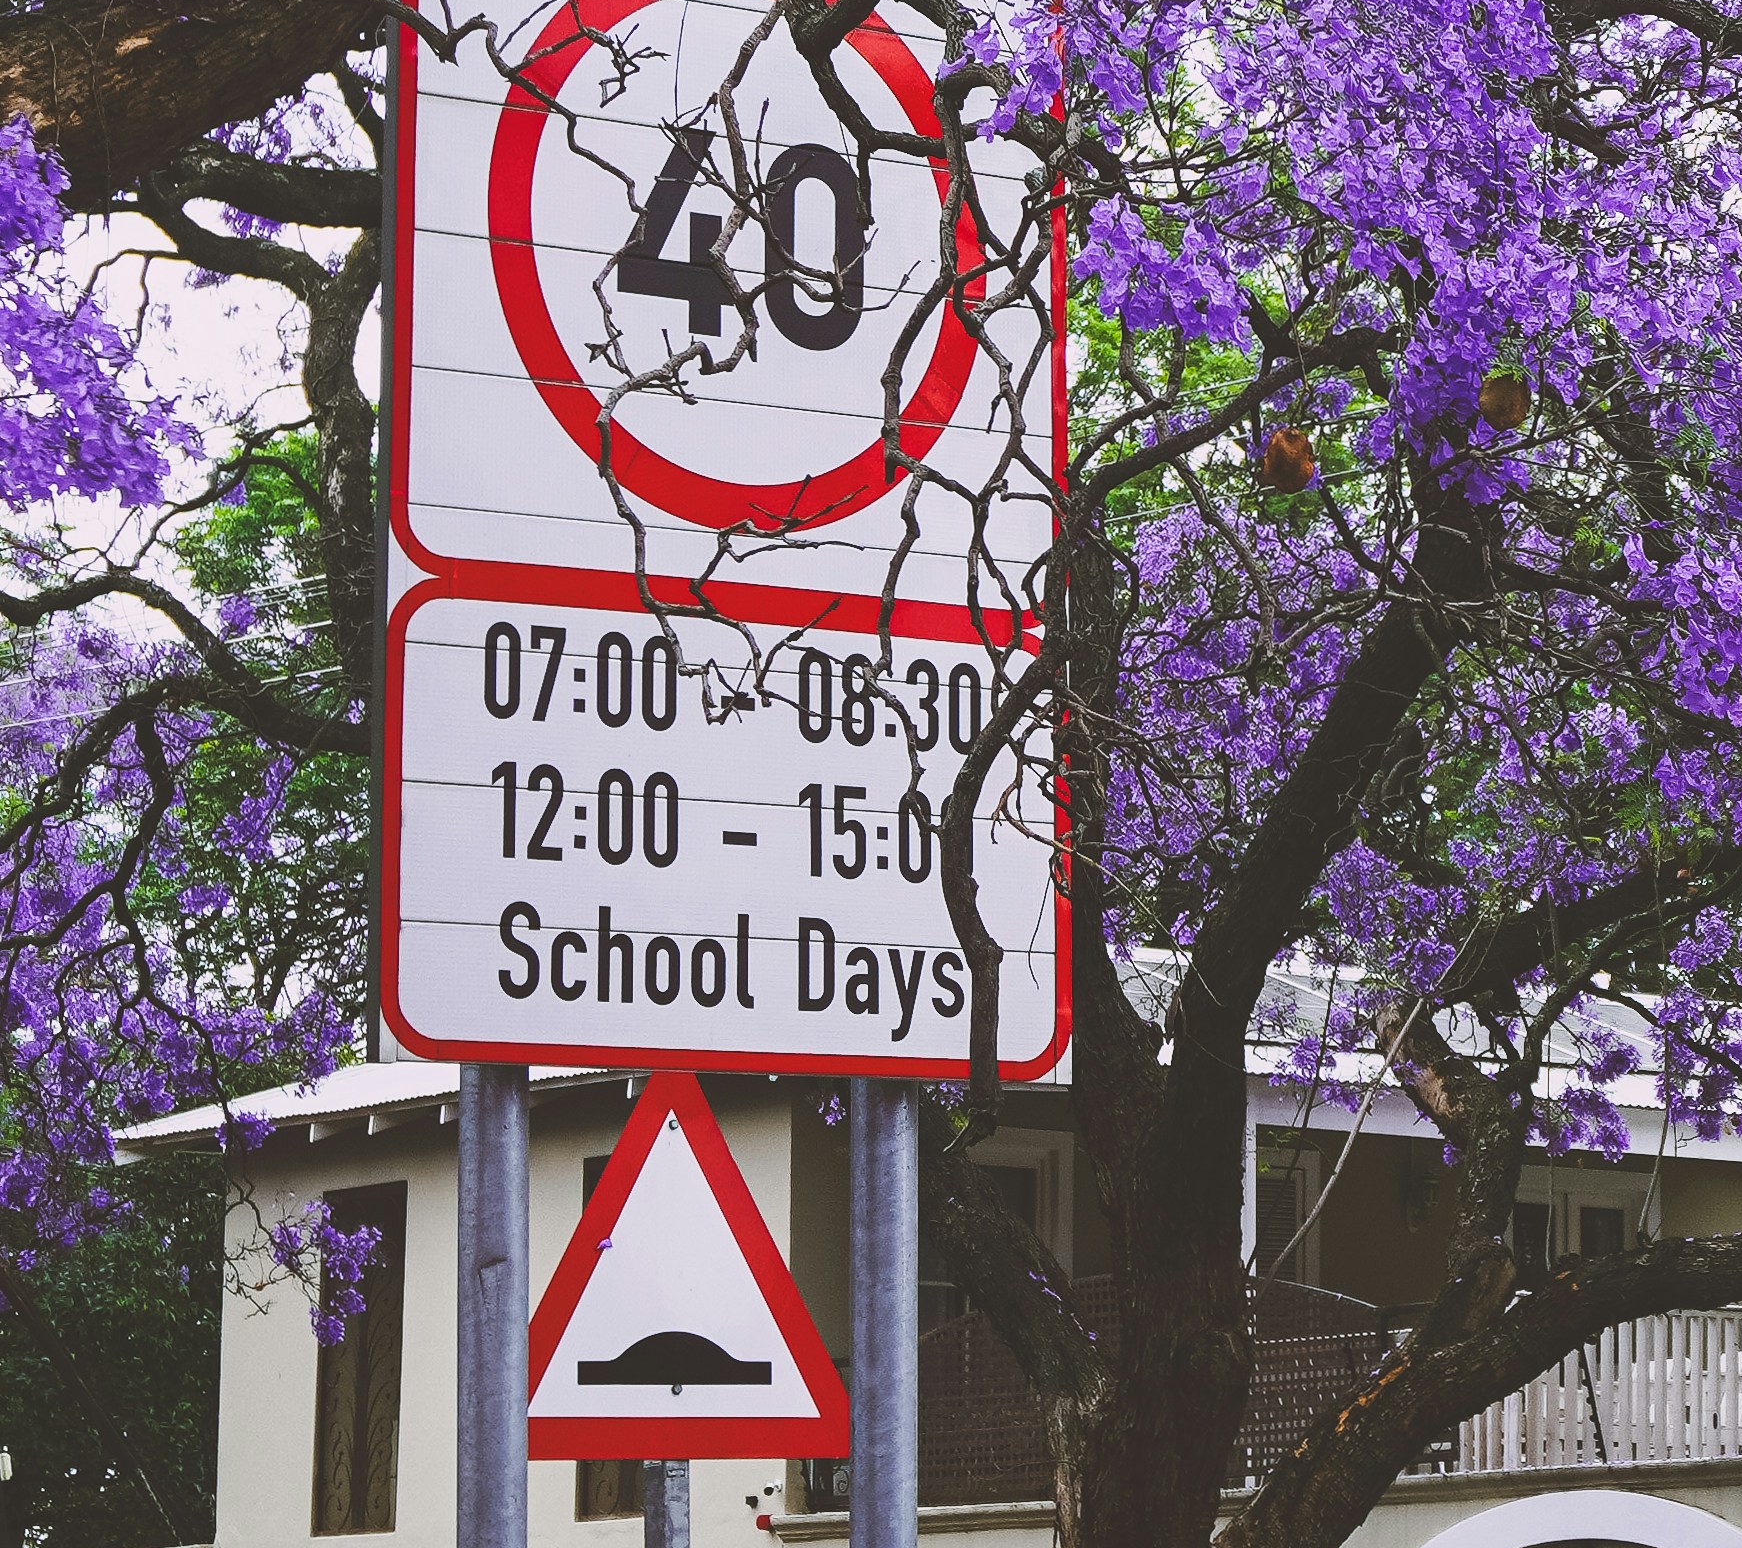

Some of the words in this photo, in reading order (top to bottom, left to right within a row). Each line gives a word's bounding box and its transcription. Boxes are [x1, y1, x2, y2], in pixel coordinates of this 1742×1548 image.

[617, 128, 865, 351] 40
[484, 621, 679, 732] 07:00
[799, 652, 982, 755] 08:30
[491, 761, 680, 868] 12:00
[799, 783, 974, 884] 15:0
[498, 901, 755, 1010] School
[797, 917, 966, 1042] Days
